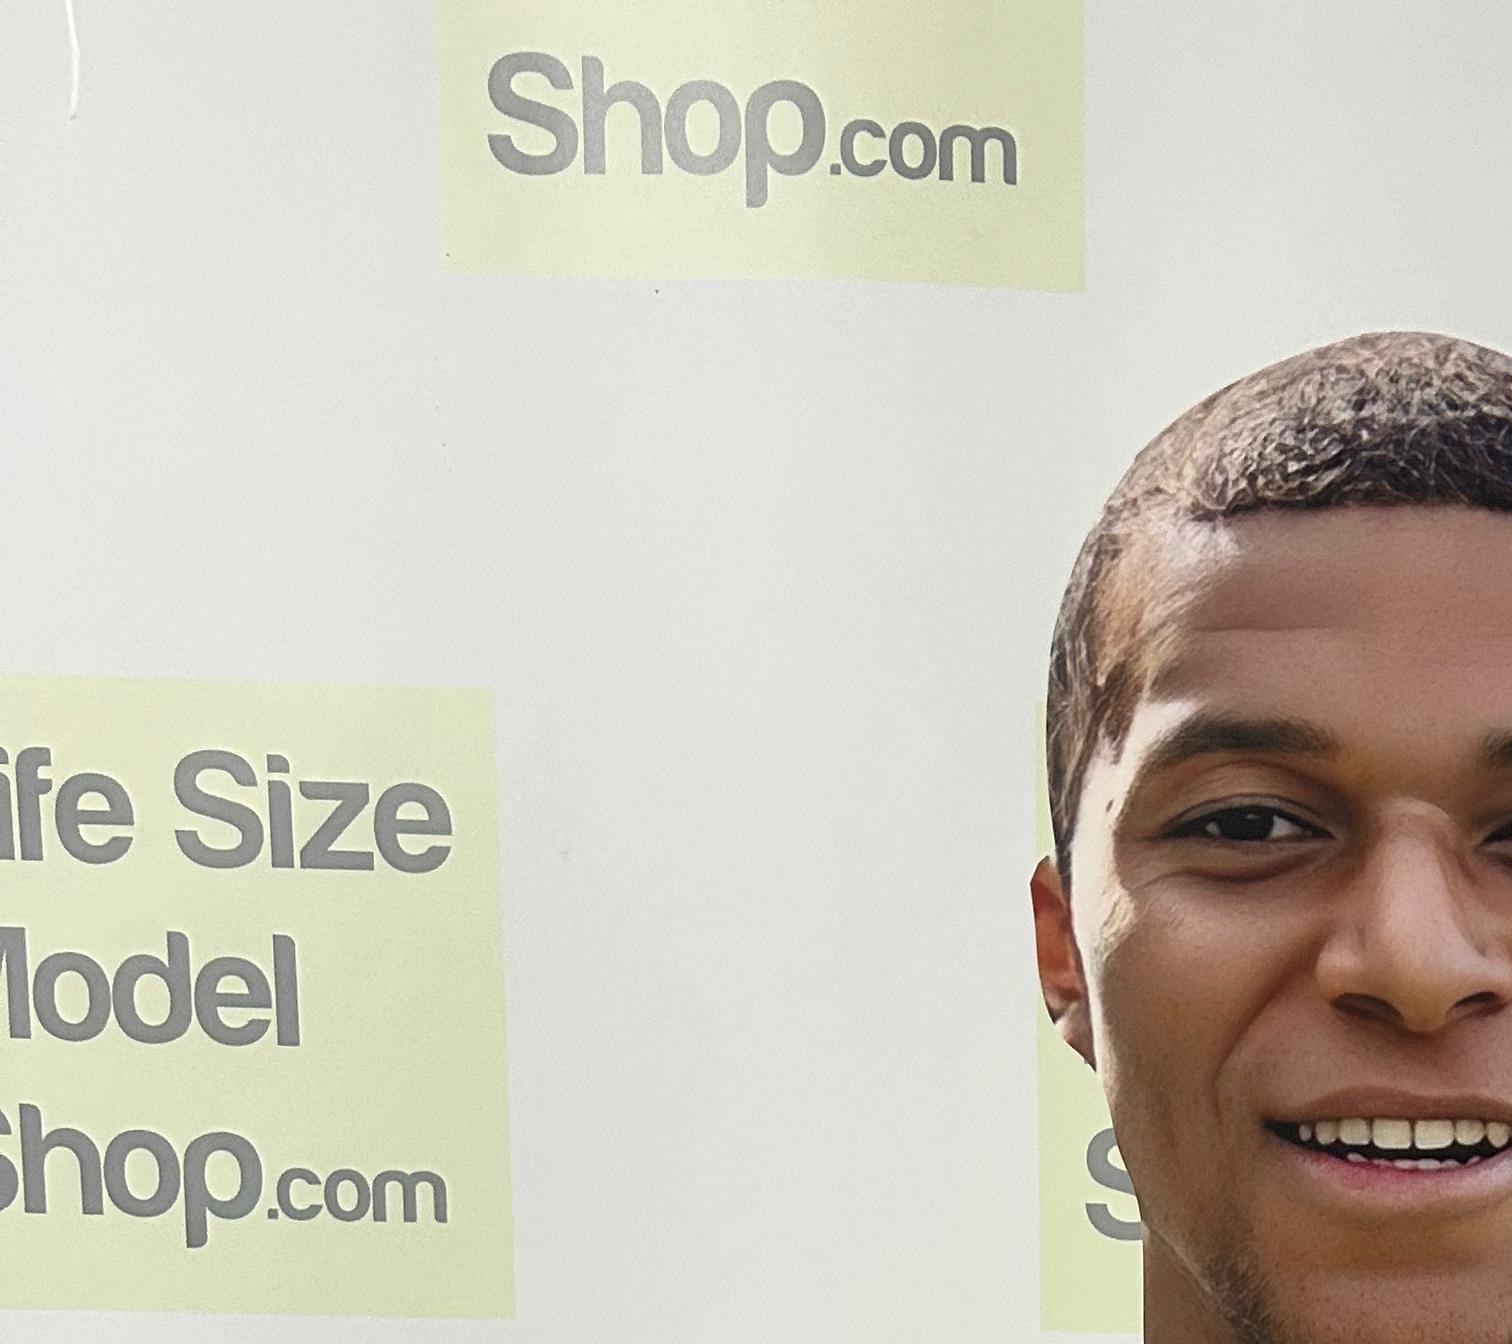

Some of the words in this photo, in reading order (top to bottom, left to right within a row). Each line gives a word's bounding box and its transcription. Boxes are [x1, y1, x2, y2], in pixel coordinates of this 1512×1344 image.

[488, 52, 1018, 208] Shop.com
[174, 750, 452, 874] Size
[0, 1103, 447, 1248] hop.com
